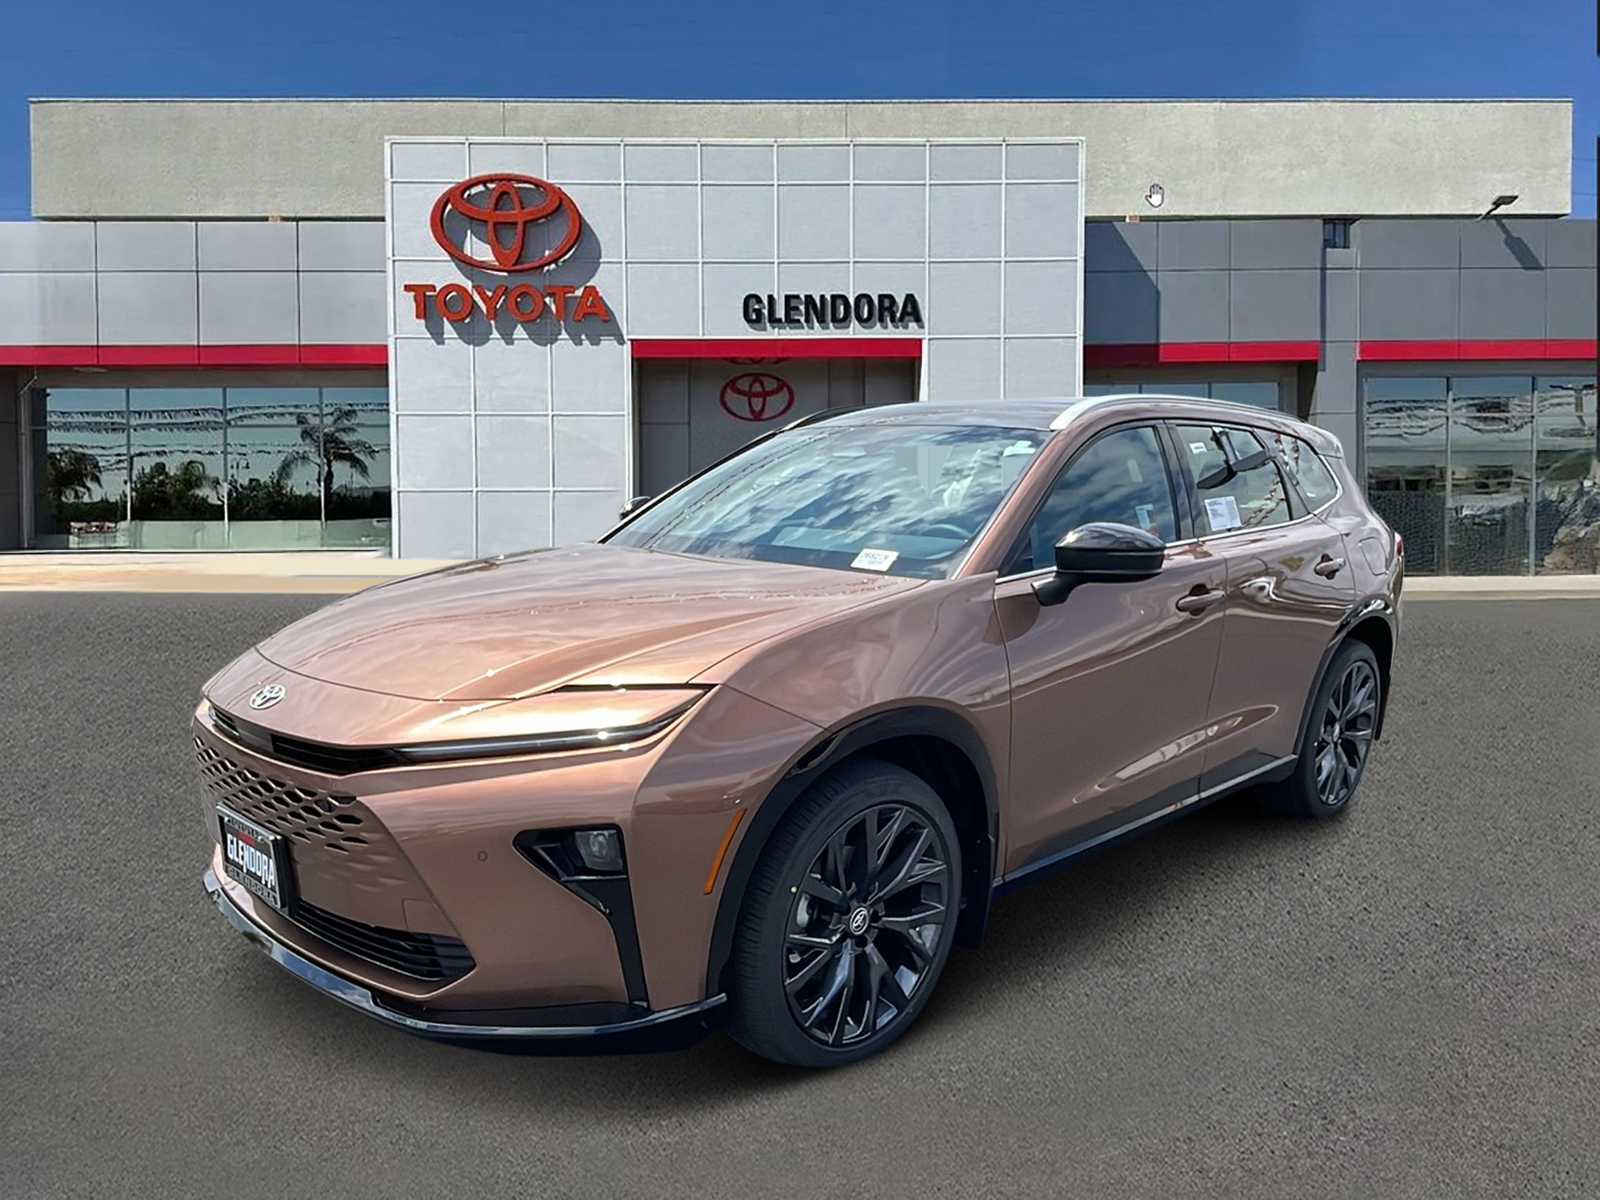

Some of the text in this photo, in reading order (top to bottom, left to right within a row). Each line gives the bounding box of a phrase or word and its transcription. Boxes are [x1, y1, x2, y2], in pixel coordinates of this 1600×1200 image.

[404, 283, 610, 323] TOYOTA
[742, 293, 923, 325] GLENDORA
[226, 833, 275, 889] GLENDORA
